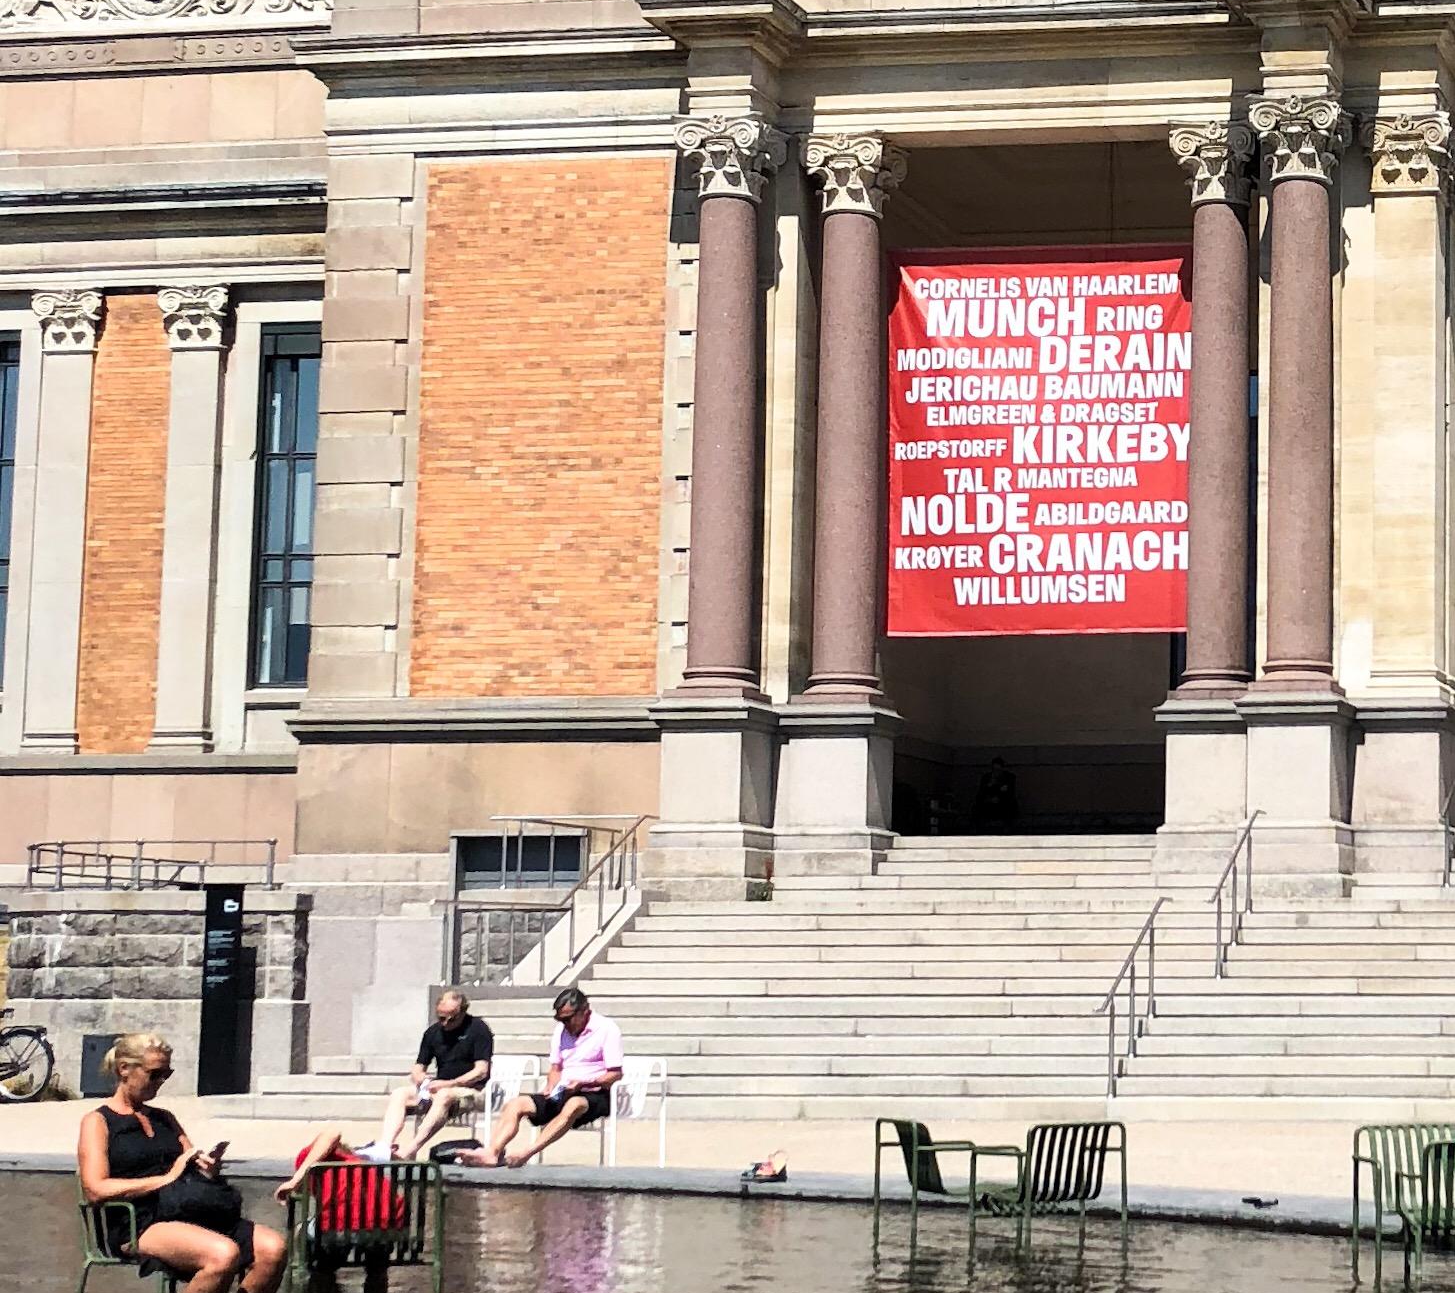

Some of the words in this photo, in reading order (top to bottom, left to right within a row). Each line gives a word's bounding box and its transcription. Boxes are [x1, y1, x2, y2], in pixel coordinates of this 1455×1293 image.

[914, 278, 1021, 299] CORNELIS
[1025, 276, 1068, 297] VAN
[1073, 273, 1178, 296] HAARLEM
[926, 297, 1085, 338] MUNCH
[1096, 305, 1163, 332] RING
[897, 347, 1032, 371] MODIGLIANI
[1038, 332, 1191, 373] DERAIN
[905, 375, 1038, 404] JERICHAU
[1043, 372, 1183, 400] BAUMANN
[926, 404, 1036, 426] ELMGREEN
[1039, 404, 1056, 423] &
[1060, 402, 1158, 423] DRAGSET
[894, 439, 1007, 460] ROEPSTORFF
[1012, 422, 1190, 464] KIRKEBY
[944, 468, 989, 494] TAL
[994, 467, 1013, 493] R
[1017, 466, 1138, 490] MANTEGNA
[900, 493, 1030, 536] NOLDE
[1034, 500, 1188, 526] ABILDGAARD
[894, 545, 983, 570] KRØYER
[988, 530, 1188, 574] CRANACH
[954, 574, 1125, 605] WILLUMSEN
